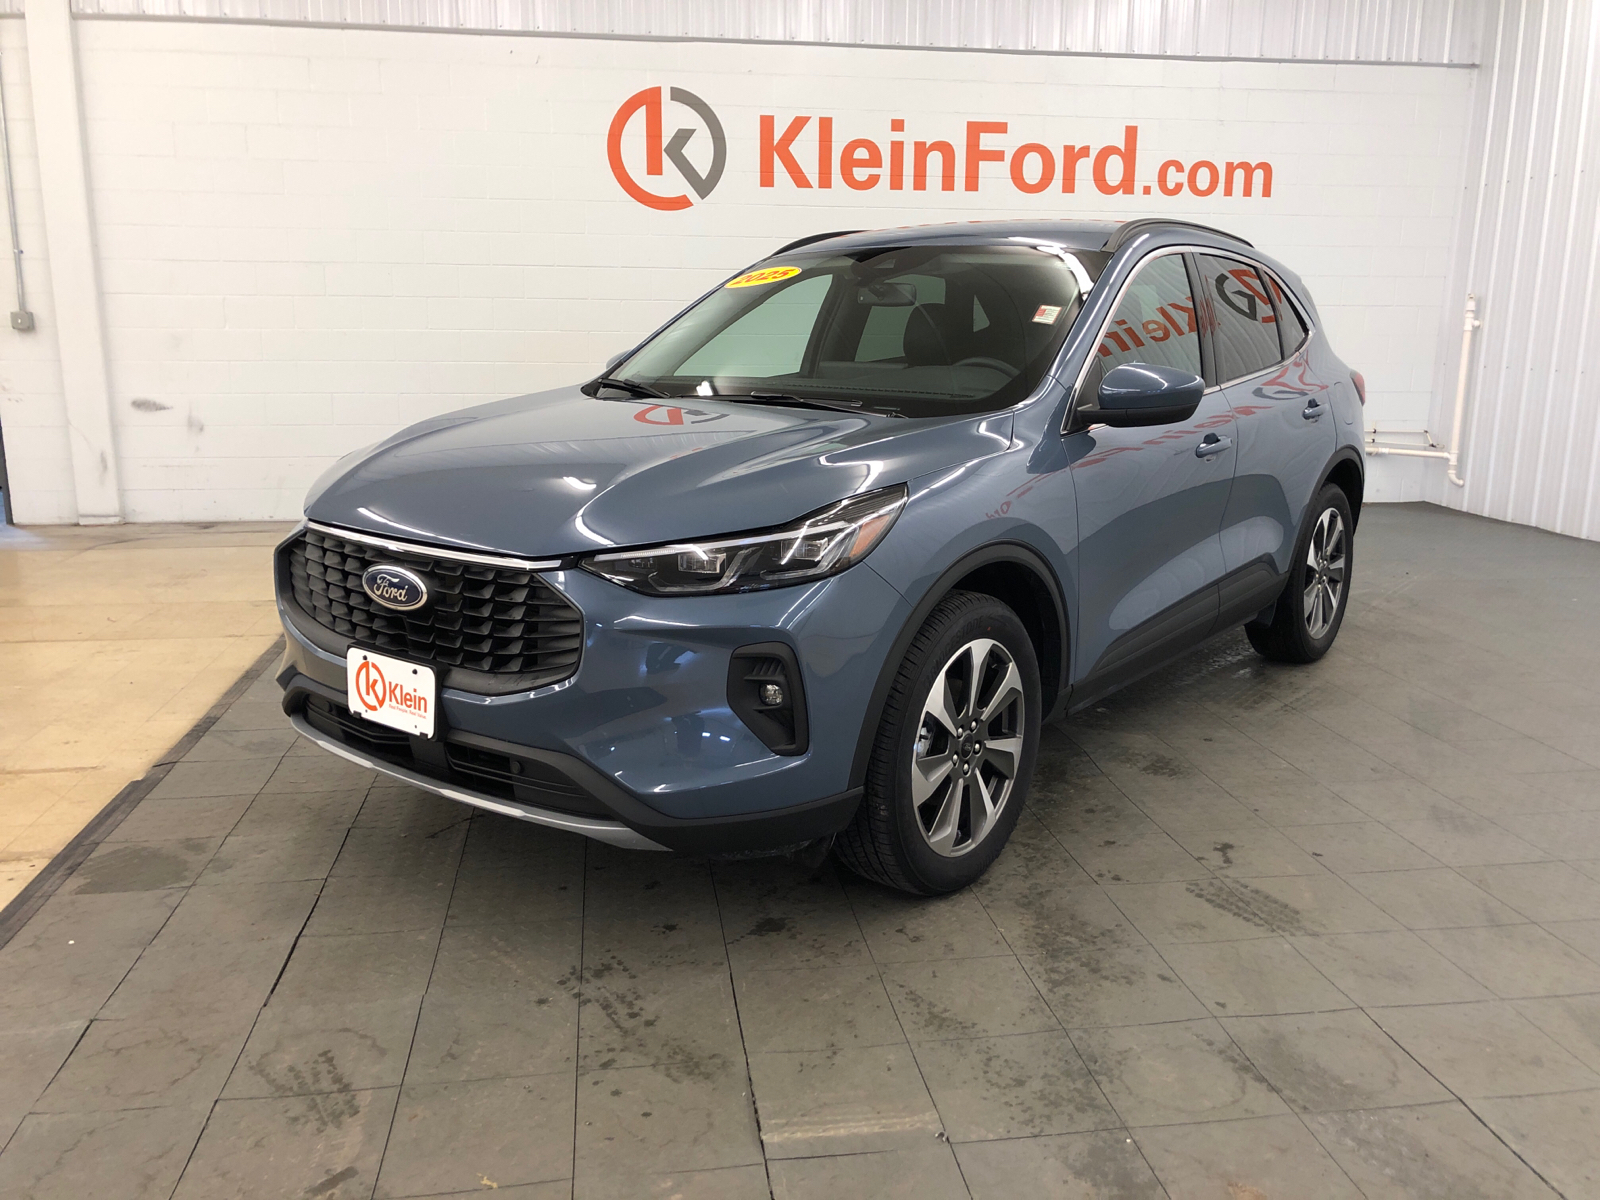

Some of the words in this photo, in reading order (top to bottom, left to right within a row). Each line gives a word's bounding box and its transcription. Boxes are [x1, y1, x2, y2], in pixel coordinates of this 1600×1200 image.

[759, 114, 1273, 198] KleinFord.com
[730, 268, 797, 285] 2025
[373, 573, 408, 601] Ford
[388, 681, 427, 712] Klein
